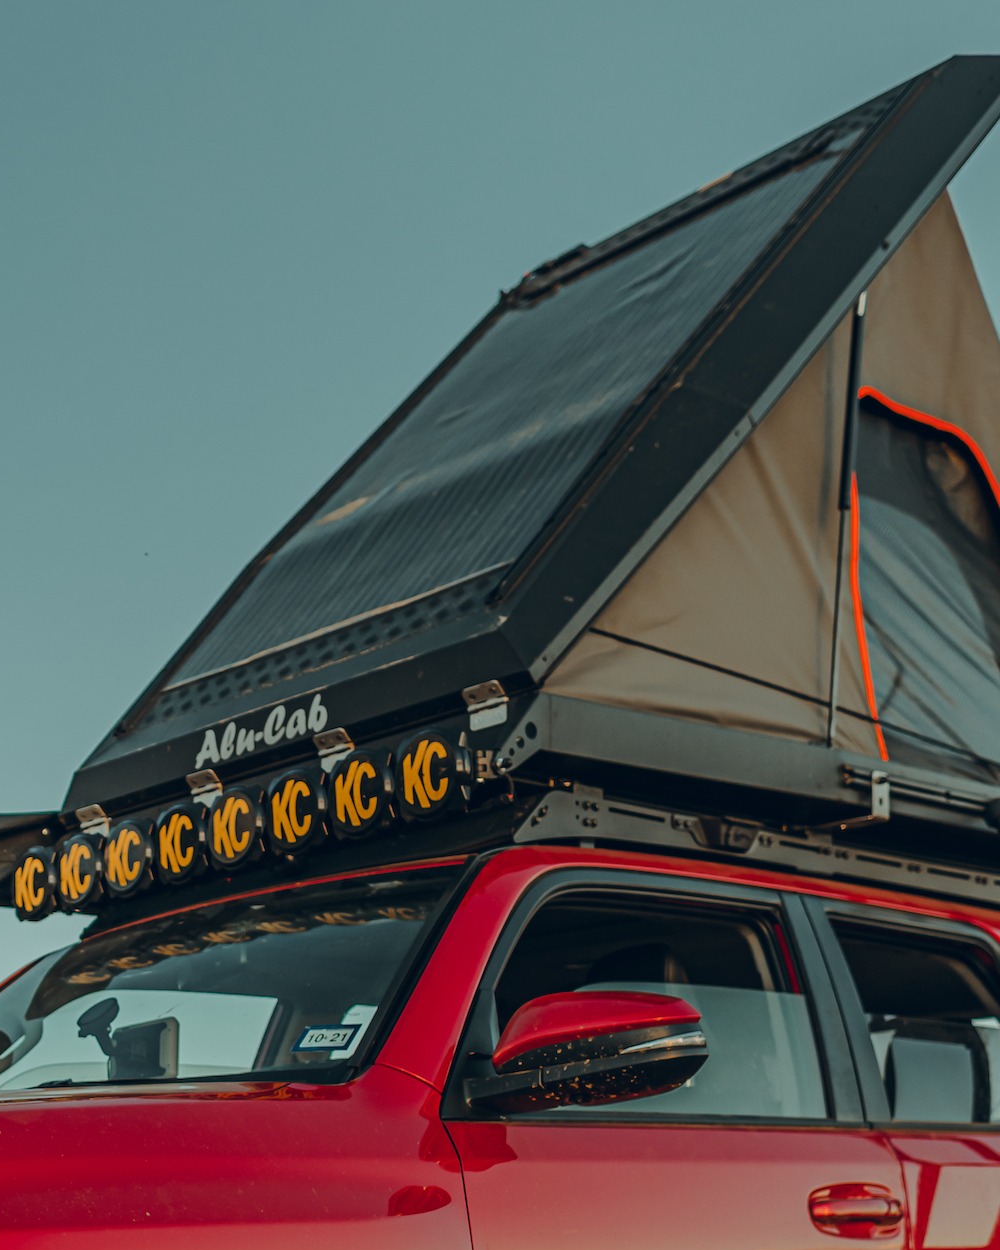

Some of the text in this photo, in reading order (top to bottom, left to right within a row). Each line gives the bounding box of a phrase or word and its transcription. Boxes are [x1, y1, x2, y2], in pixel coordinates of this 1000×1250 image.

[194, 693, 328, 769] Alu-Cab
[334, 760, 378, 827] KC
[402, 739, 449, 809] KC
[213, 797, 251, 859] KC
[271, 779, 312, 843] KC
[60, 844, 91, 899] KC
[107, 830, 141, 886] KC
[159, 813, 194, 873] KC
[15, 857, 45, 912] KC
